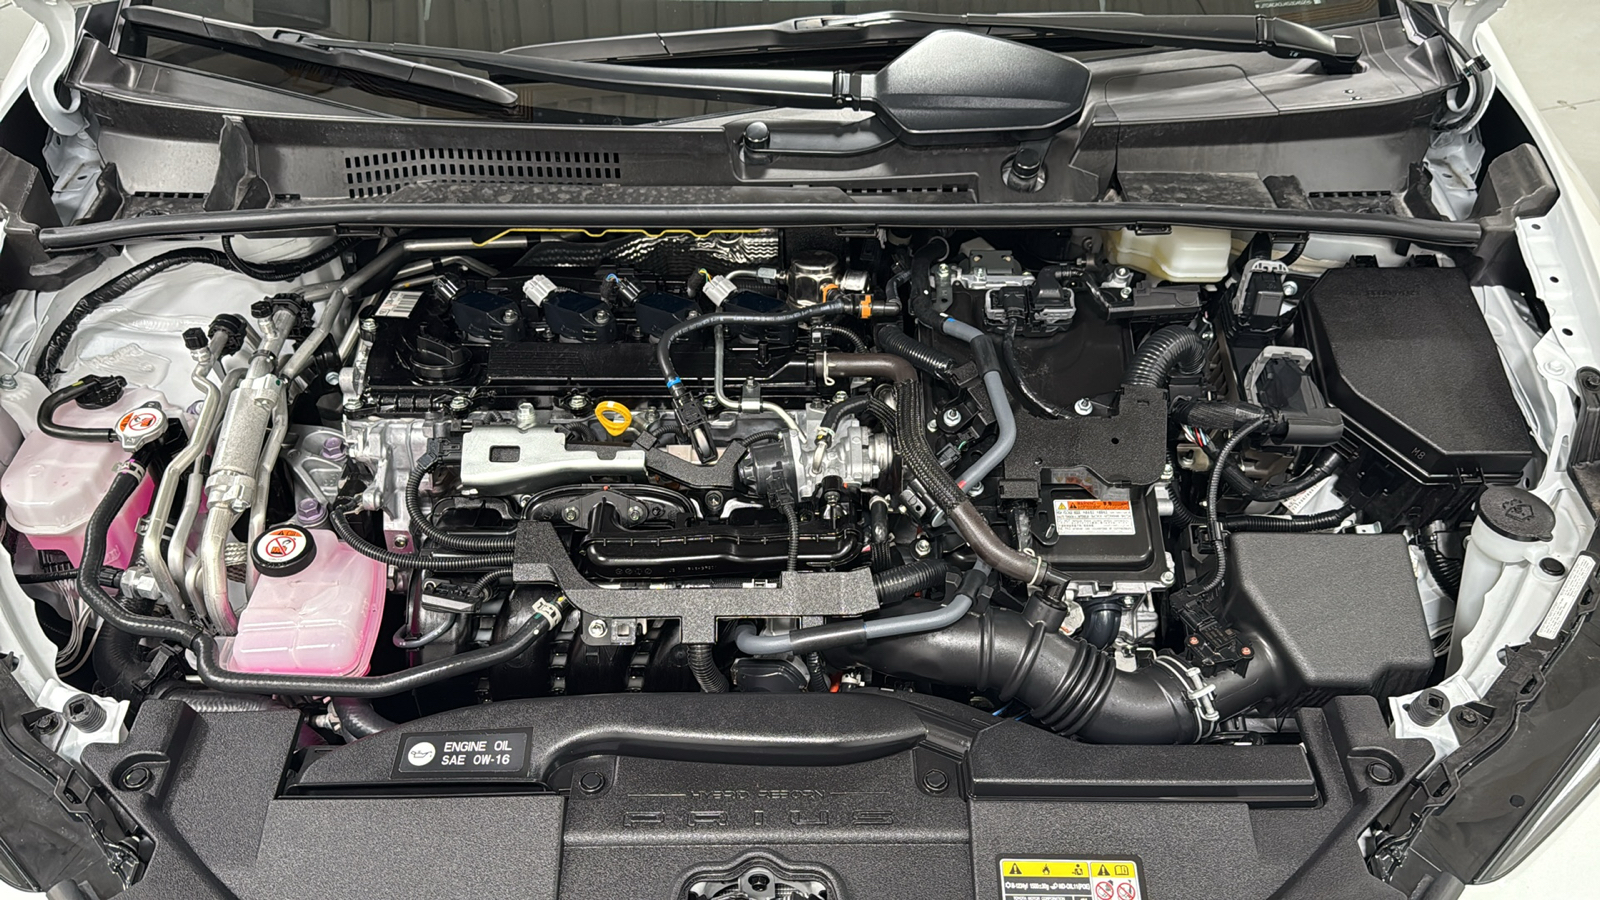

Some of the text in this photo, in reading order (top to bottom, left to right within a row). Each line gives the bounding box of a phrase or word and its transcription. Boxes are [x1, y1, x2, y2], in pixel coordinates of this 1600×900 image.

[443, 740, 512, 752] ENGINE OIL
[441, 754, 510, 765] SAE 0W-16
[690, 789, 824, 799] HYBRID REBORN
[623, 810, 894, 827] PRIUS
